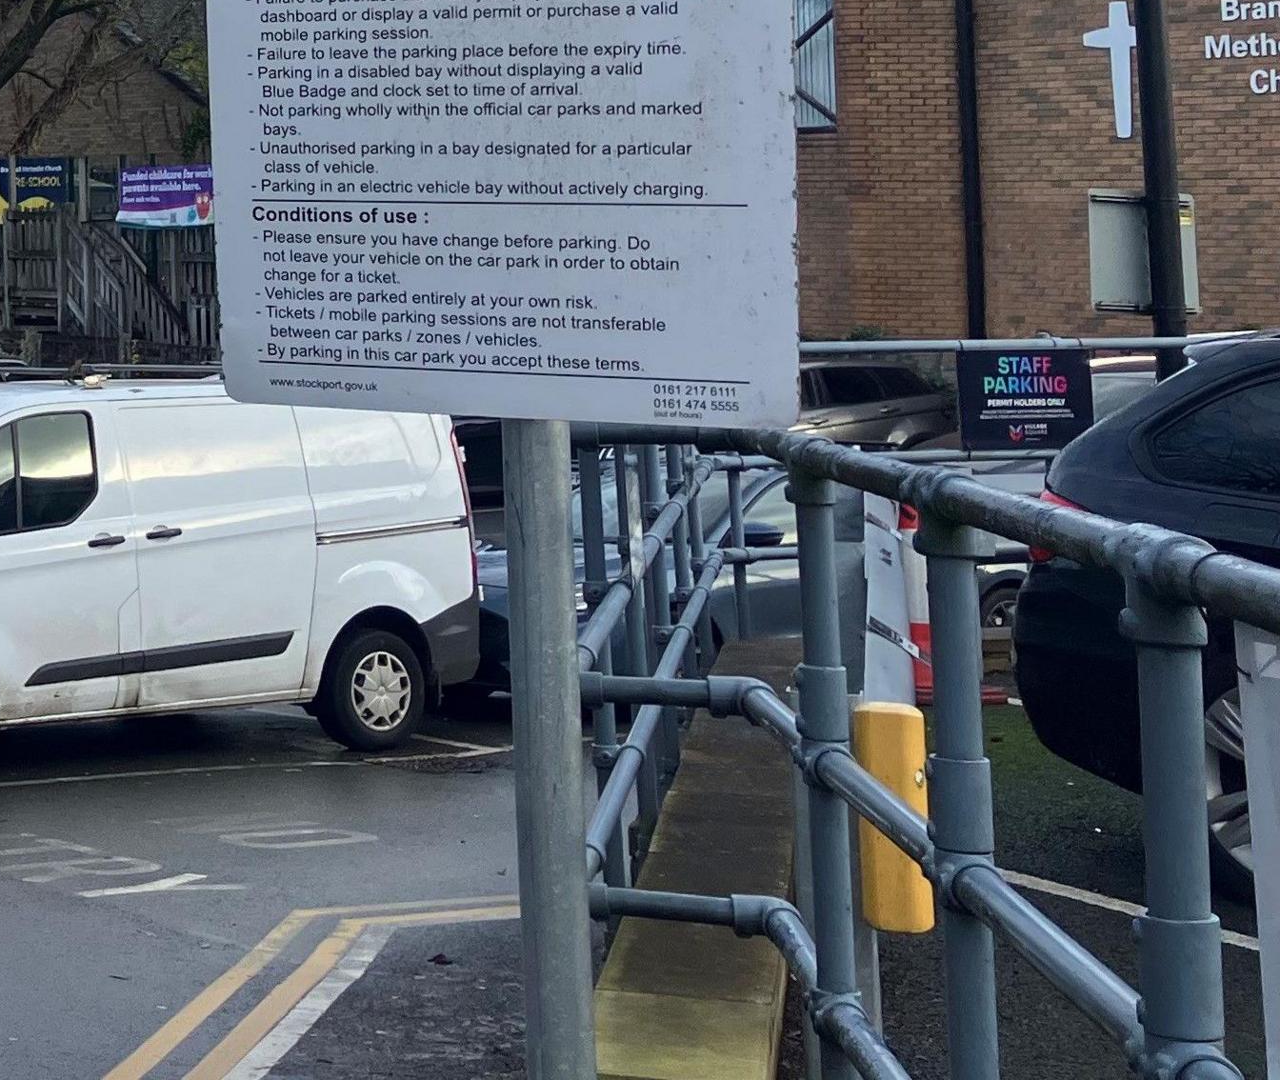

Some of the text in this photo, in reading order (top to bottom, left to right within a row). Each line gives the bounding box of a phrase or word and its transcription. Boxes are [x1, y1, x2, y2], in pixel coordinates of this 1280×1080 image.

[260, 25, 432, 44] mobile parking session.
[1204, 33, 1280, 59] Meth
[263, 122, 301, 139] bays.
[149, 169, 182, 180] childcare
[183, 168, 194, 179] for
[264, 159, 378, 174] class of vehicle.
[15, 176, 62, 188] RE-SCHOOL
[150, 181, 182, 192] available
[252, 206, 352, 223] Conditions
[358, 207, 378, 224] of
[383, 211, 417, 224] use
[264, 268, 400, 285] change for a ticket.
[998, 356, 1052, 375] STAFF
[269, 378, 377, 393] www.stockport.gov.uk
[653, 383, 735, 398] 0161 217 6111
[983, 376, 1068, 395] PARKING
[653, 398, 739, 412] 0161 474 5555
[987, 398, 1066, 407] PERMIT HOLDERS ONLY
